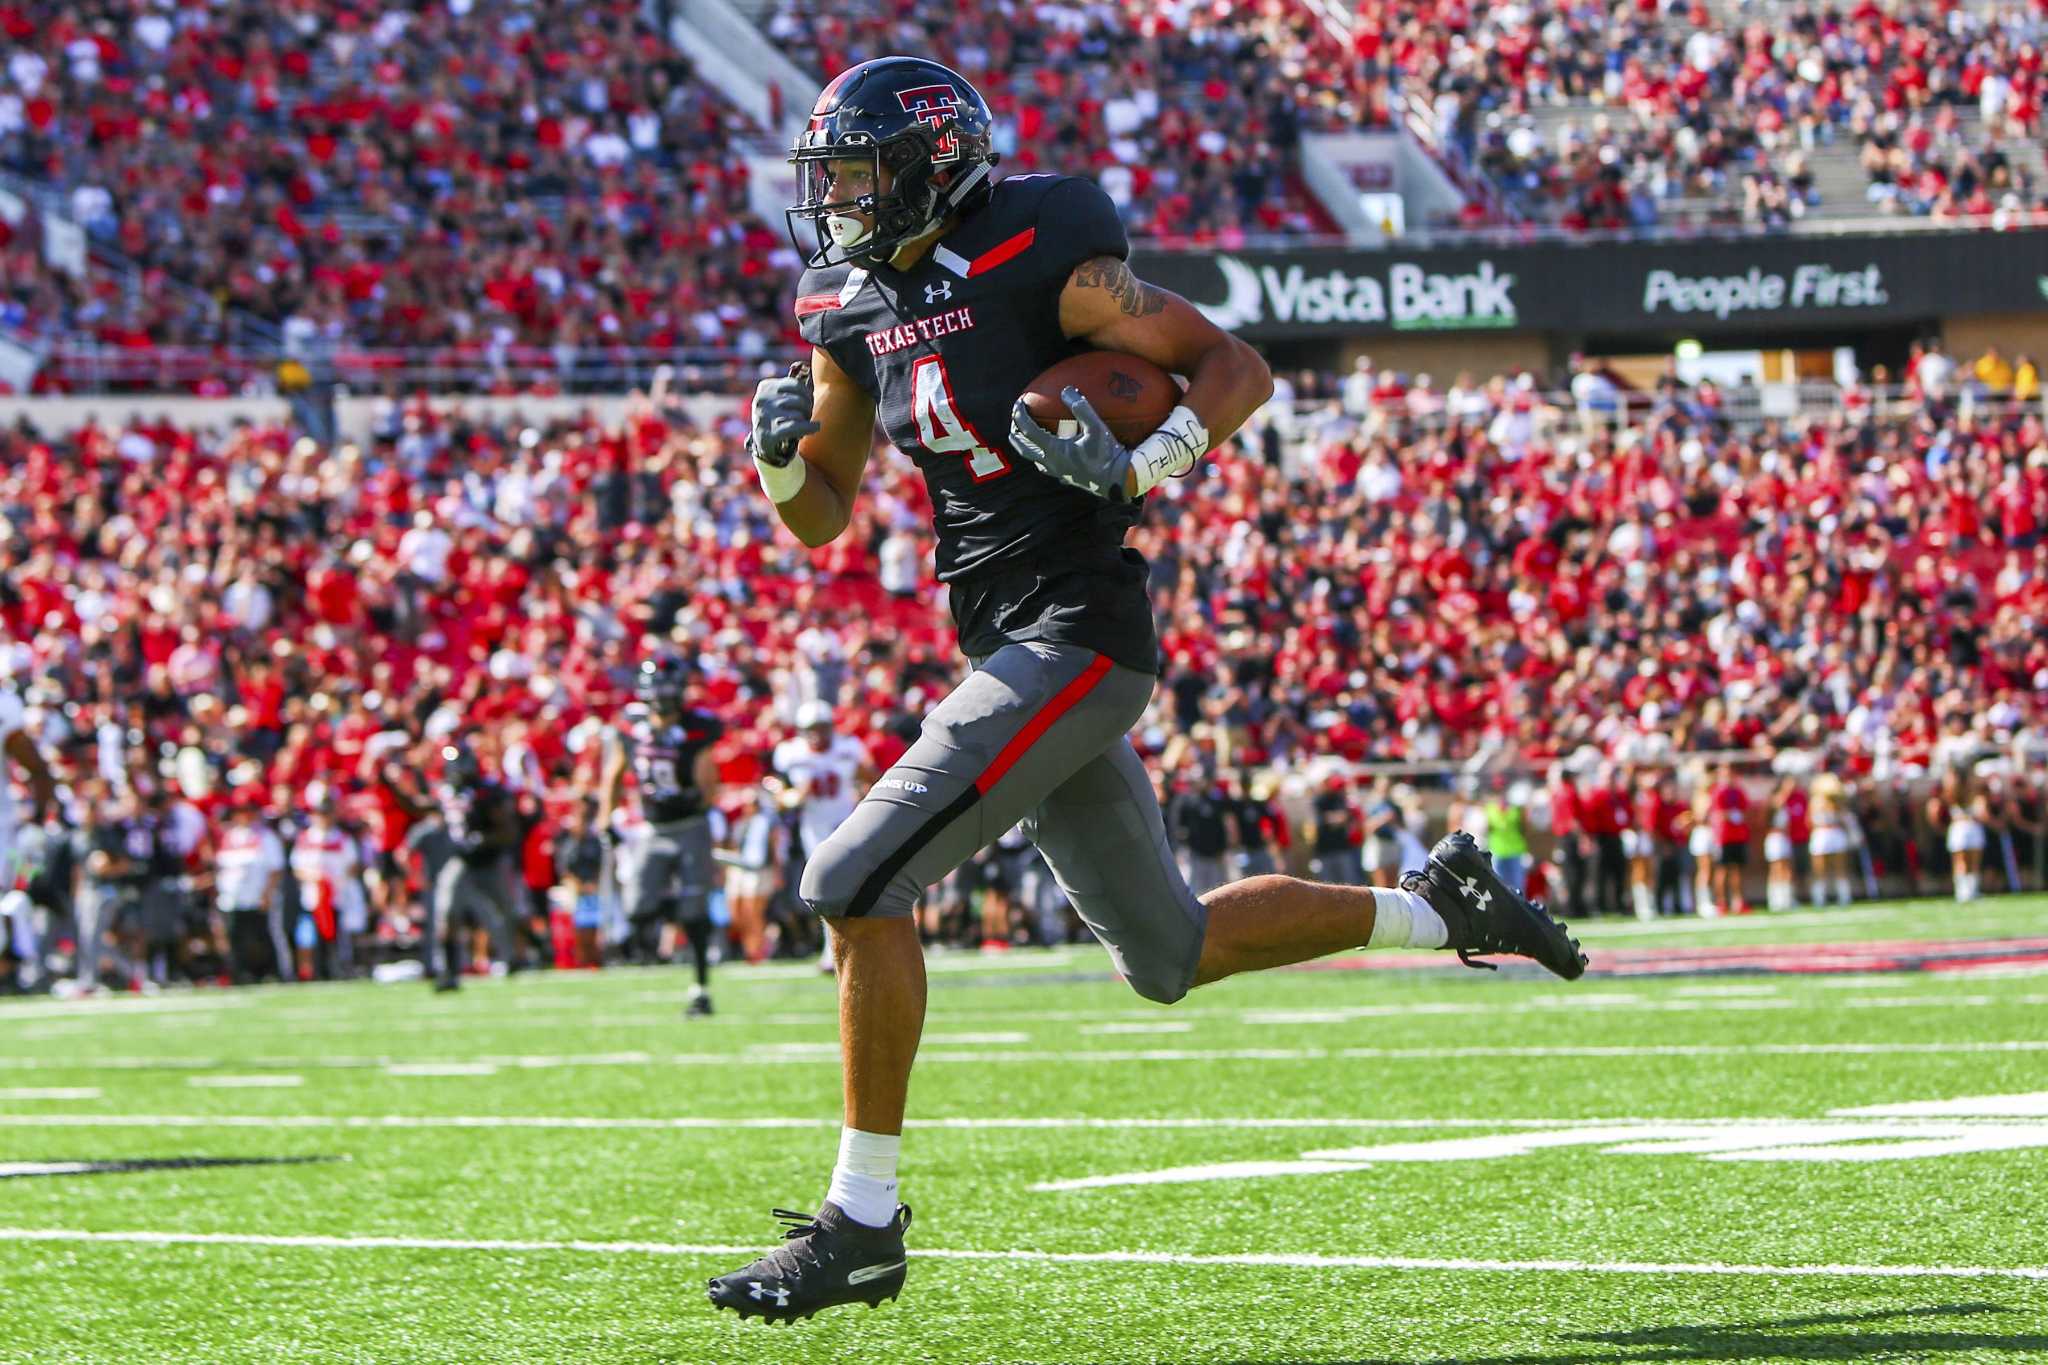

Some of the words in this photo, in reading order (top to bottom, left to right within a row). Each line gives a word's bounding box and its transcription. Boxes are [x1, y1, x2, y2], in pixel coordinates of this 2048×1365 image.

[1262, 264, 1386, 323] Vista
[1389, 259, 1516, 320] Bank
[1643, 265, 1786, 320] People
[1790, 263, 1889, 308] First.
[864, 323, 918, 357] TEXAS
[917, 307, 976, 341] TECH
[911, 352, 1012, 484] 4
[904, 781, 928, 793] UP
